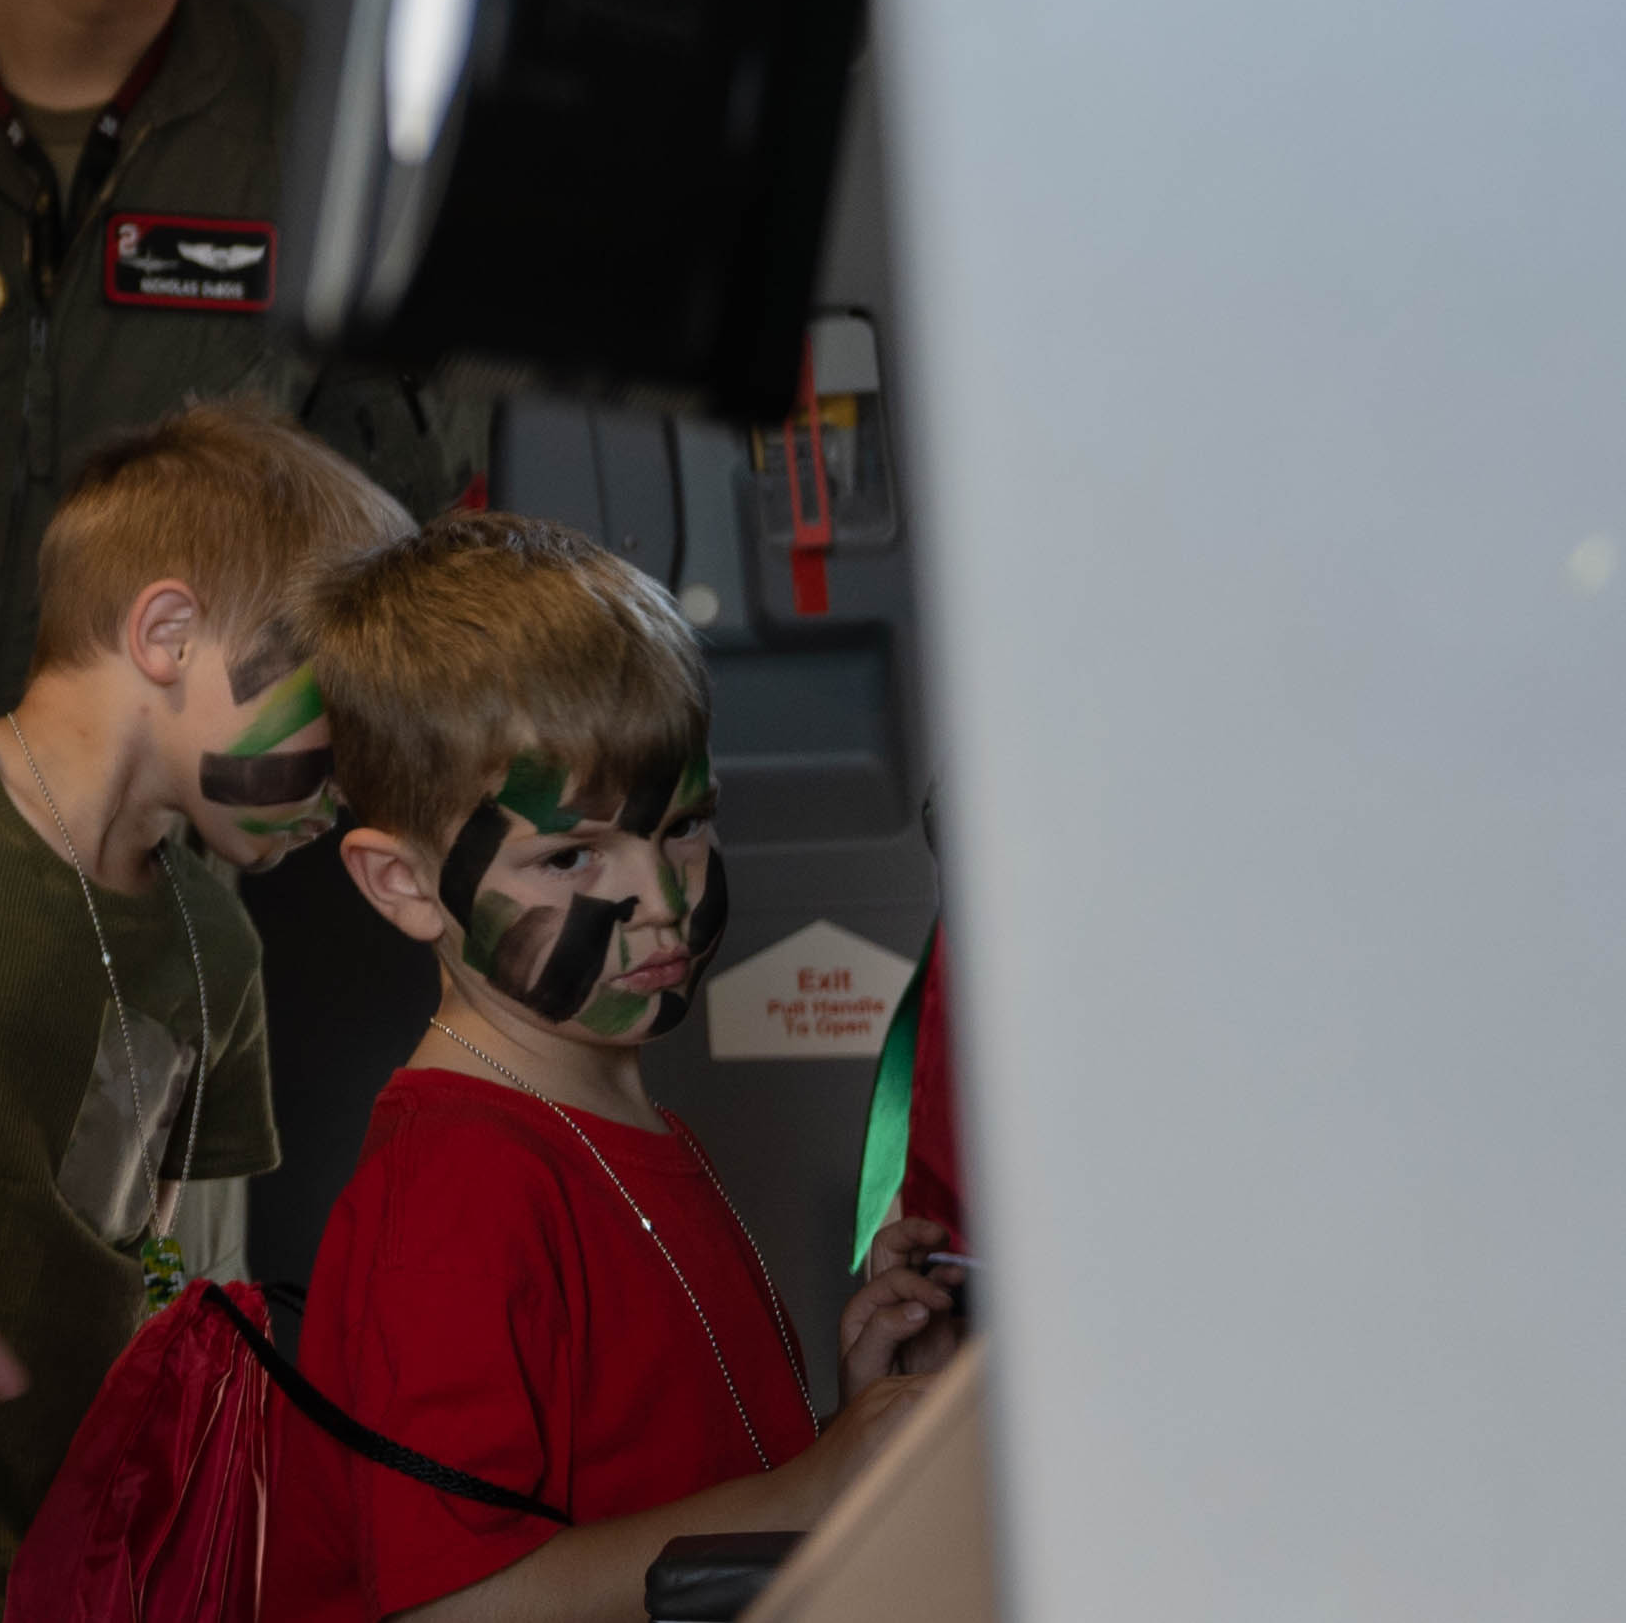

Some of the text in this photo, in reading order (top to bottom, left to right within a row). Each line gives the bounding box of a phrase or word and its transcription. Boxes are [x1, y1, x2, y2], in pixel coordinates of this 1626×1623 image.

[796, 968, 852, 992] Exit
[767, 997, 886, 1017] Pull Handle
[784, 1019, 871, 1040] To Open
